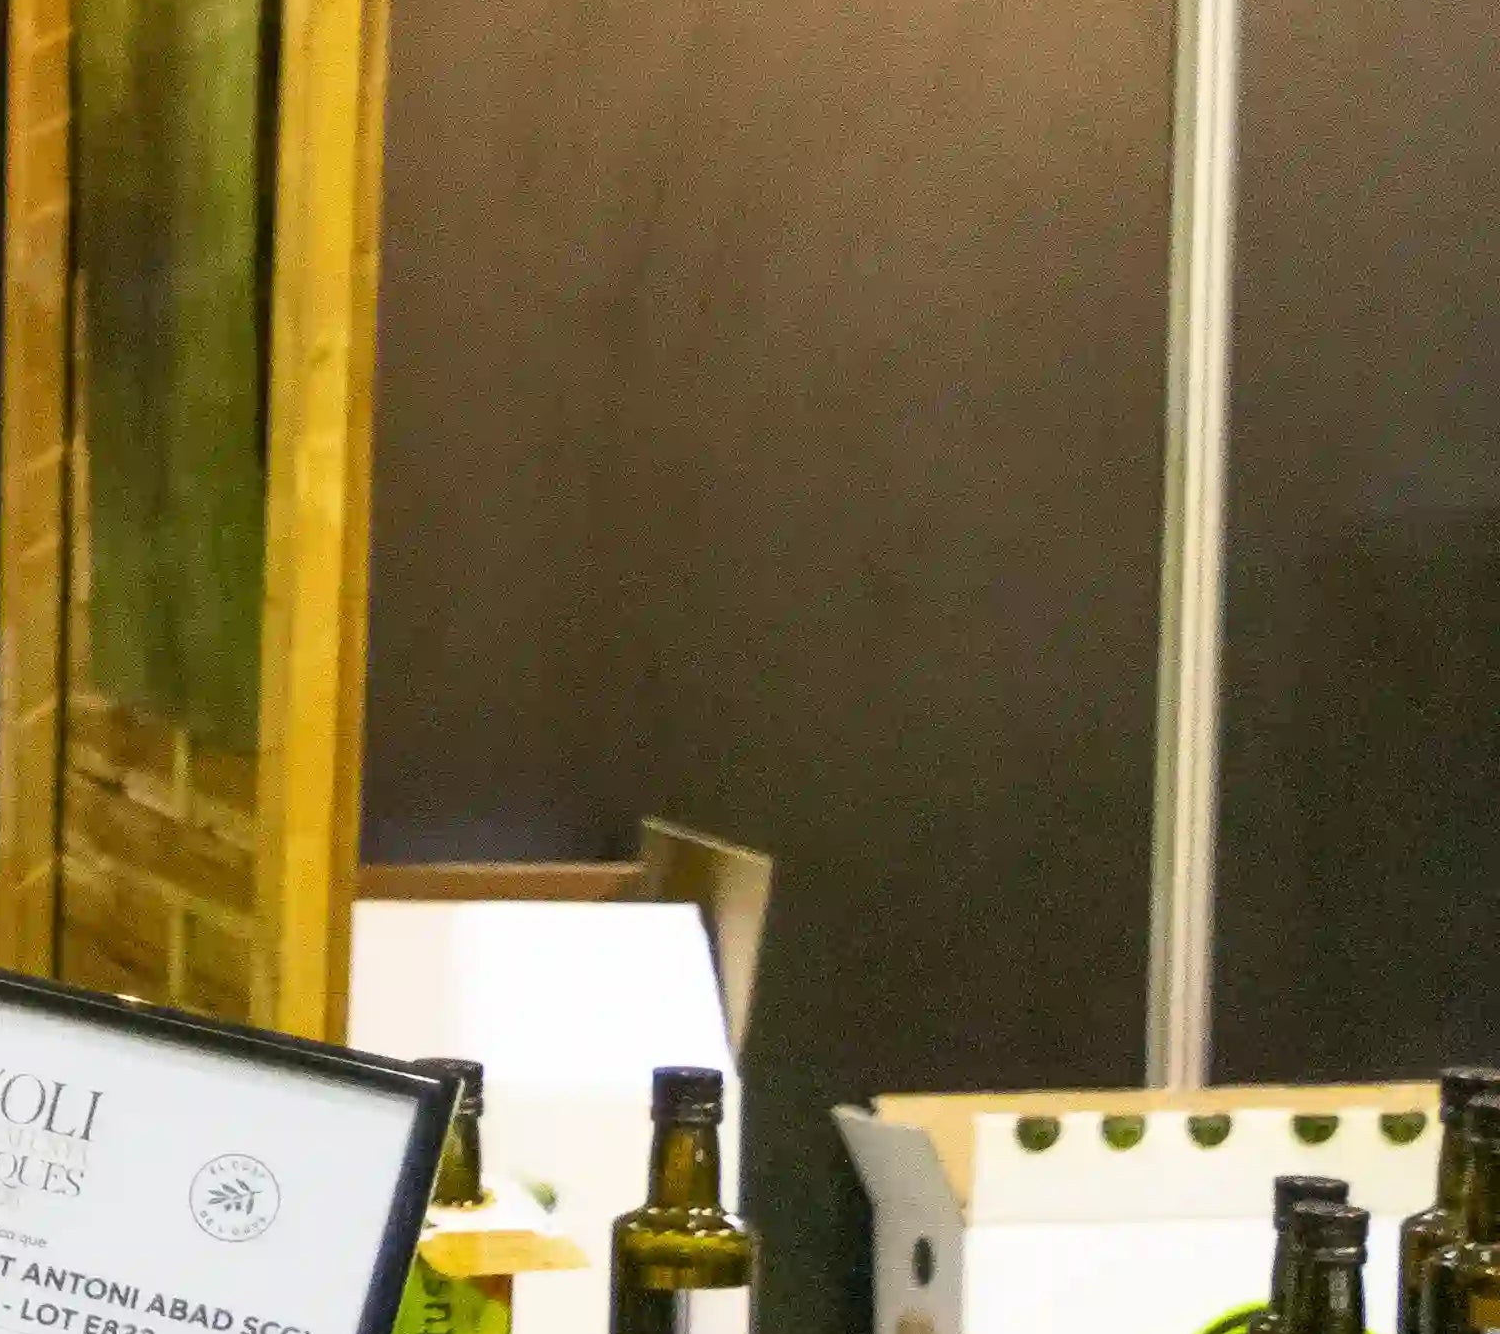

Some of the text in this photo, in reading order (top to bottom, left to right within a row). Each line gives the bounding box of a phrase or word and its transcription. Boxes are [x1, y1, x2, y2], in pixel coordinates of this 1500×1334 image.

[16, 1231, 47, 1251] que
[19, 1261, 140, 1310] ANTONI
[144, 1292, 234, 1332] ABAD
[19, 1297, 79, 1331] LOT
